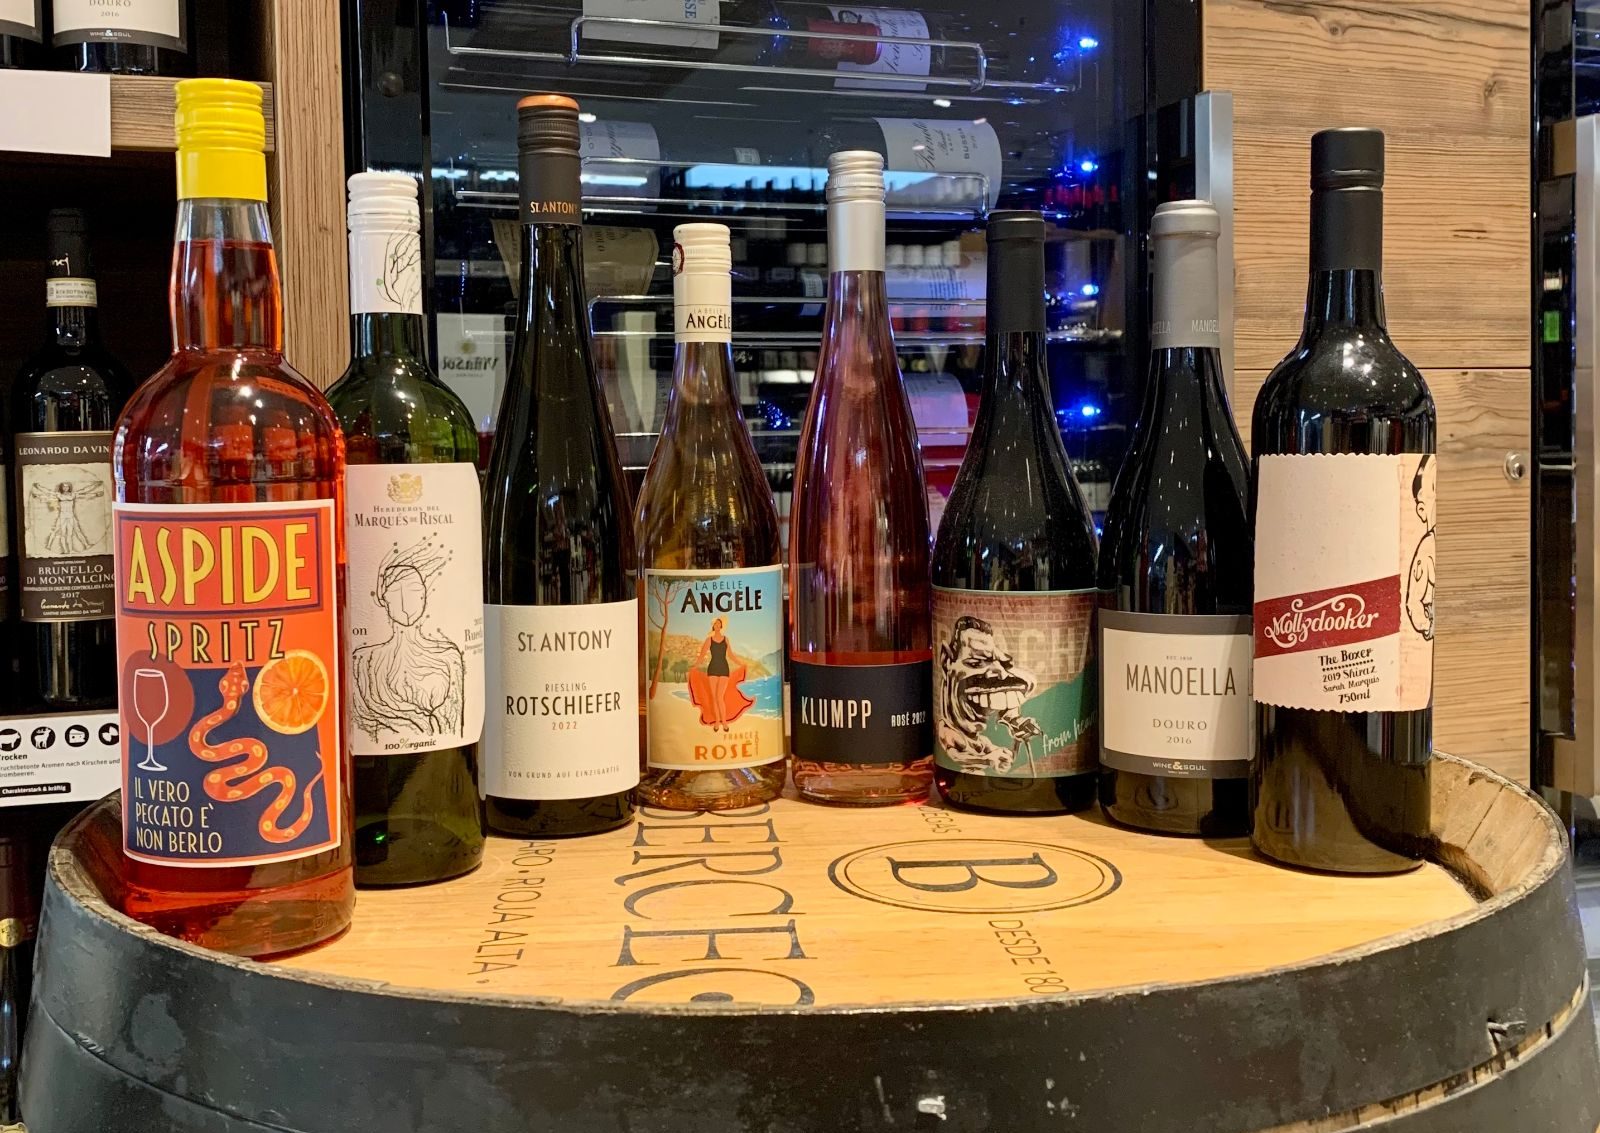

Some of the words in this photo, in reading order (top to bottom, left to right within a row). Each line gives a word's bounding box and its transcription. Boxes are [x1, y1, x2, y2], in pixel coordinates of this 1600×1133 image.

[19, 446, 70, 456] LEONARDO
[73, 446, 88, 454] DA
[420, 511, 455, 525] RISCAL
[38, 564, 104, 575] BRUNELLO
[127, 522, 313, 607] ASPIDE
[26, 576, 36, 585] DI
[695, 582, 708, 591] LA
[712, 580, 743, 590] BELLE
[1264, 593, 1380, 649] Mollydooker
[352, 627, 367, 636] on
[540, 628, 613, 652] ANTONY
[148, 618, 286, 664] SPRITZ
[1318, 654, 1339, 667] The
[1340, 648, 1373, 662] Boxer
[1126, 663, 1237, 696] MANOELLA
[1322, 672, 1342, 683] 2019
[1342, 665, 1377, 679] Shiraz
[545, 682, 587, 693] RIESLING
[1323, 682, 1345, 692] Sarah
[1348, 676, 1380, 688] Marquis
[505, 691, 621, 716] ROTSCHIEFER
[1338, 688, 1371, 704] 750ml
[801, 696, 872, 729] KLUMPP
[551, 720, 578, 731] 2022
[1152, 718, 1208, 731] DOURO
[1167, 735, 1192, 745] 2016
[508, 770, 522, 778] VON
[526, 771, 552, 779] GRUND
[1, 786, 41, 795] Charakterstark
[134, 776, 144, 799] IL
[148, 778, 190, 803] VERO
[135, 801, 194, 828] PECCATO
[136, 826, 163, 851] NON
[168, 831, 222, 854] BERLO
[886, 852, 1058, 893] B
[488, 877, 546, 925] RIOJA
[467, 929, 529, 976] ALTA
[988, 919, 1051, 966] DESDE
[1020, 969, 1070, 994] 180
